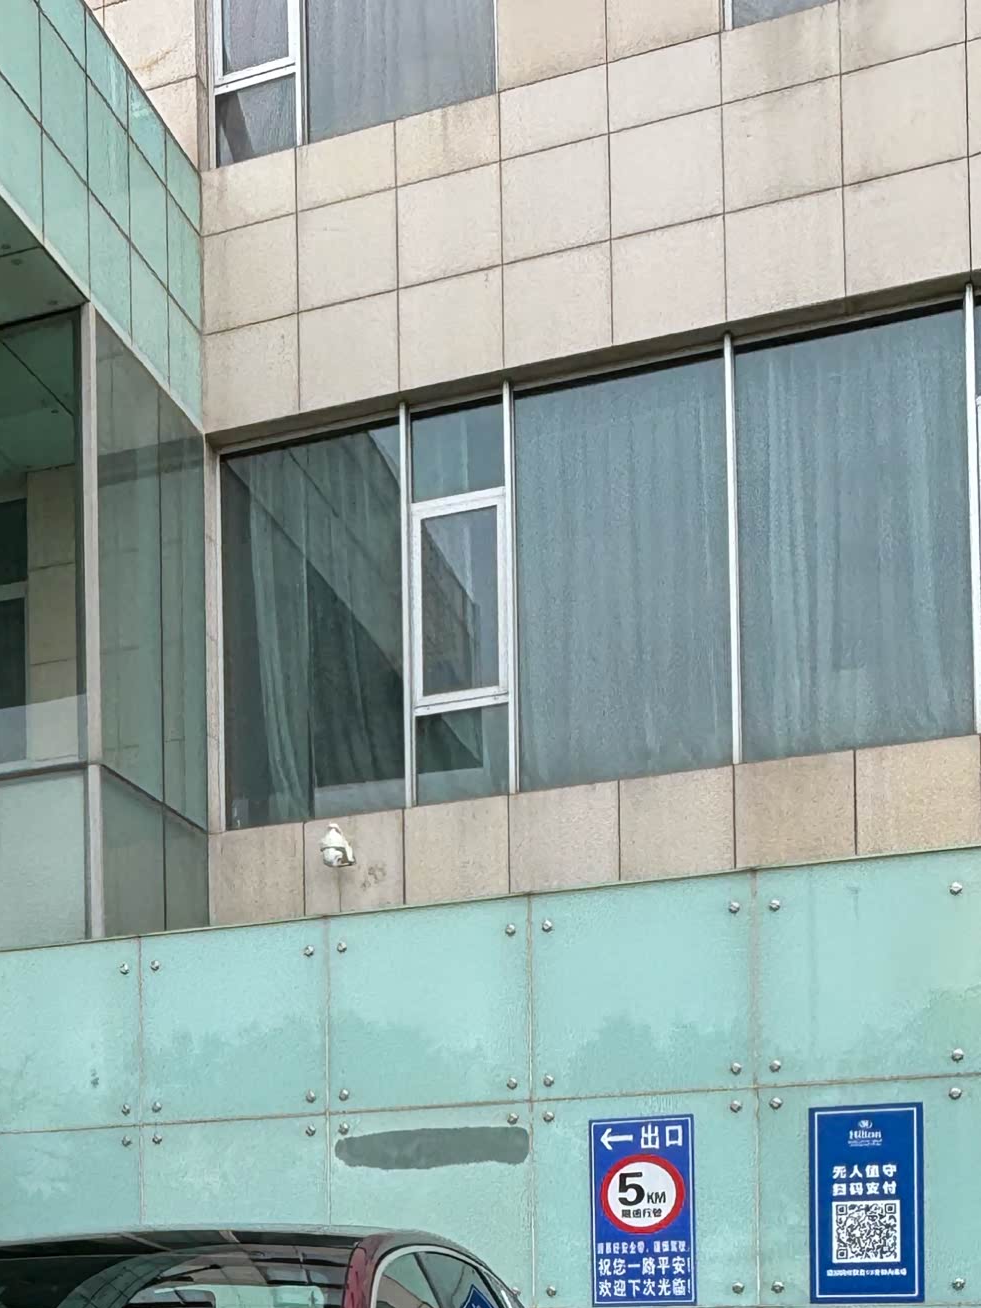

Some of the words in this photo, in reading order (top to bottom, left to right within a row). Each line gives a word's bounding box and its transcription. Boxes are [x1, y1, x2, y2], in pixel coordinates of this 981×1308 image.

[640, 1123, 683, 1149] 出口
[832, 1164, 897, 1179] 无人值守
[832, 1181, 897, 1197] 扫码支付
